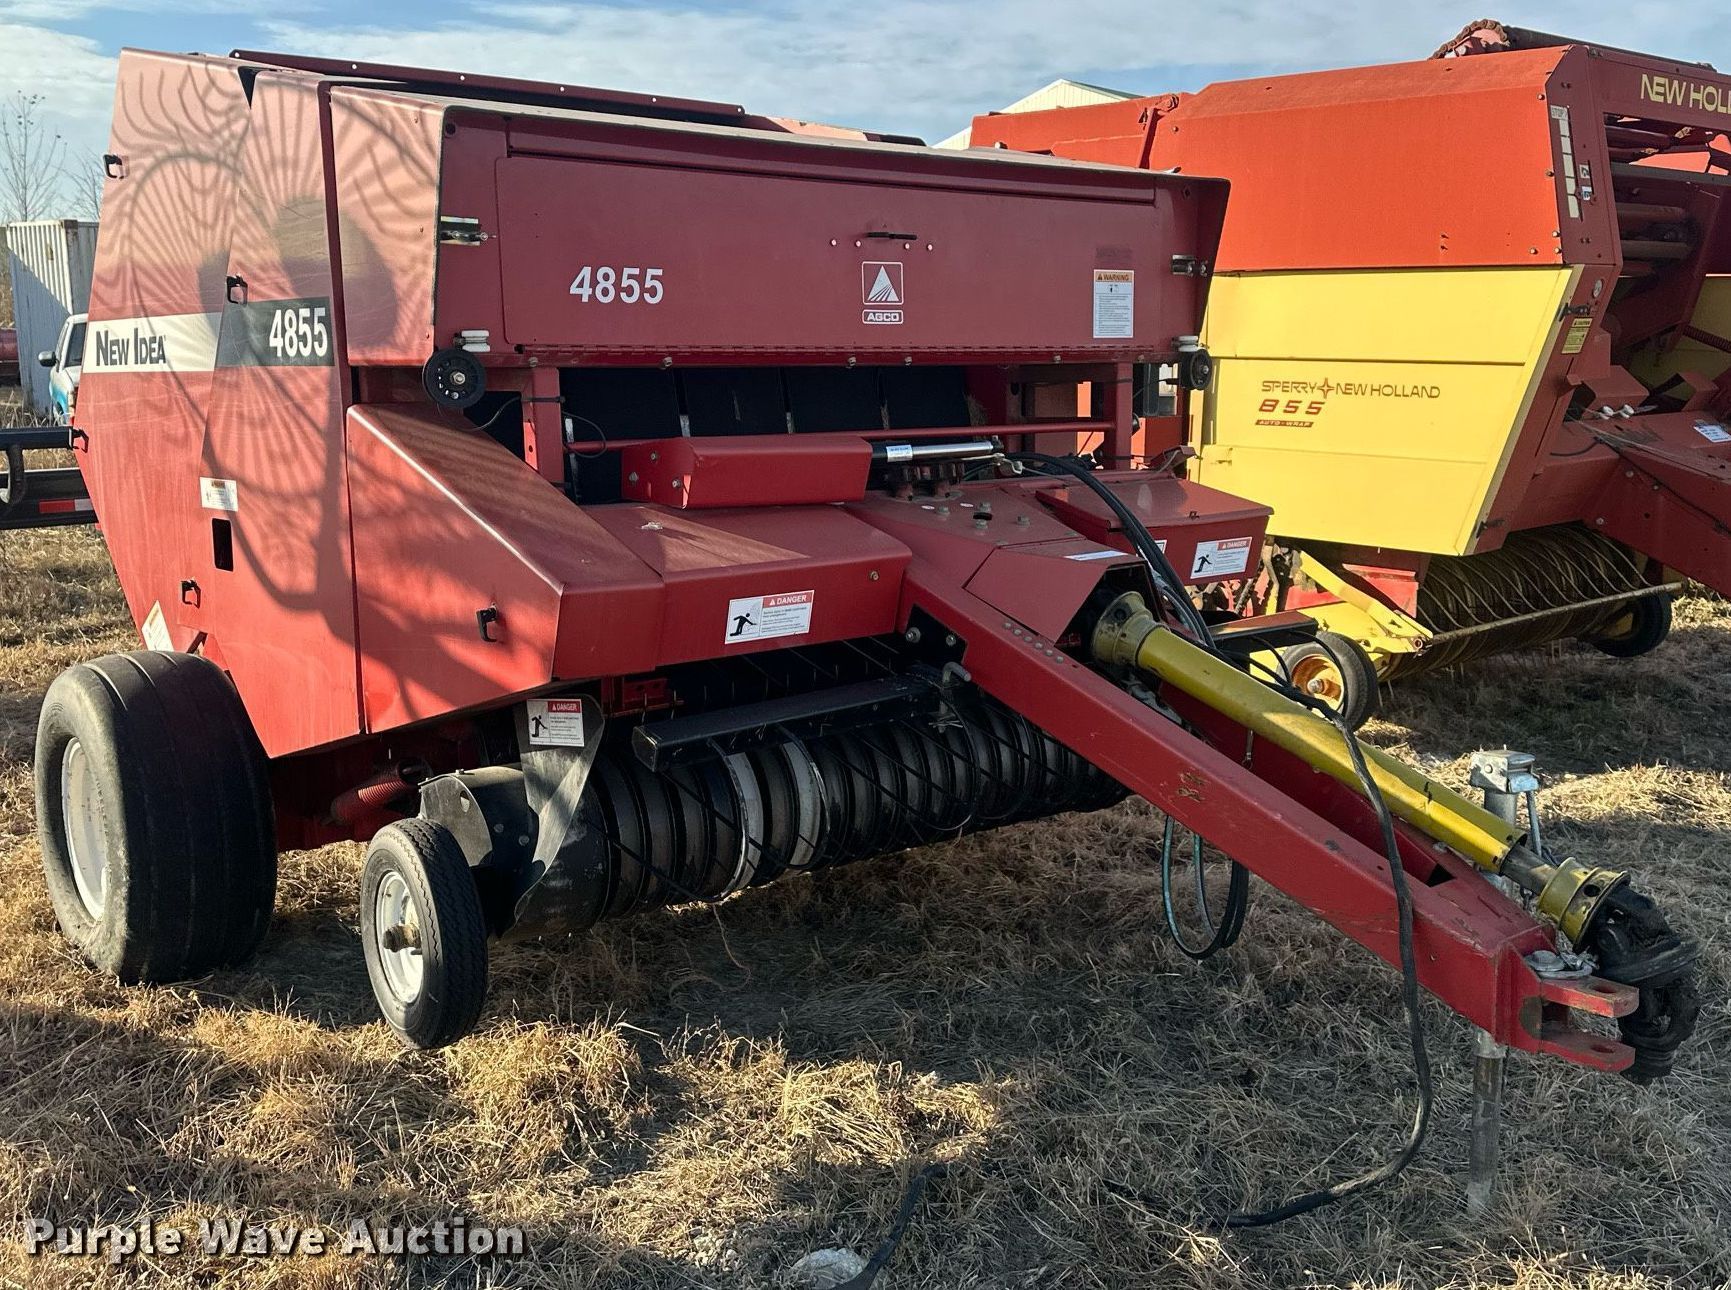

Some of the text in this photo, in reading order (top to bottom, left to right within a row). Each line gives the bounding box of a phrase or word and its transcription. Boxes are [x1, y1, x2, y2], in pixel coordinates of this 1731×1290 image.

[1640, 74, 1687, 106] NEW
[1103, 273, 1129, 281] WARNING
[569, 266, 664, 304] 4855
[867, 312, 899, 321] AGCO
[269, 307, 328, 357] 4855
[1261, 380, 1441, 399] SPERRY NEW HOLLAND
[776, 595, 807, 605] DANGER
[557, 703, 578, 711] DANGER
